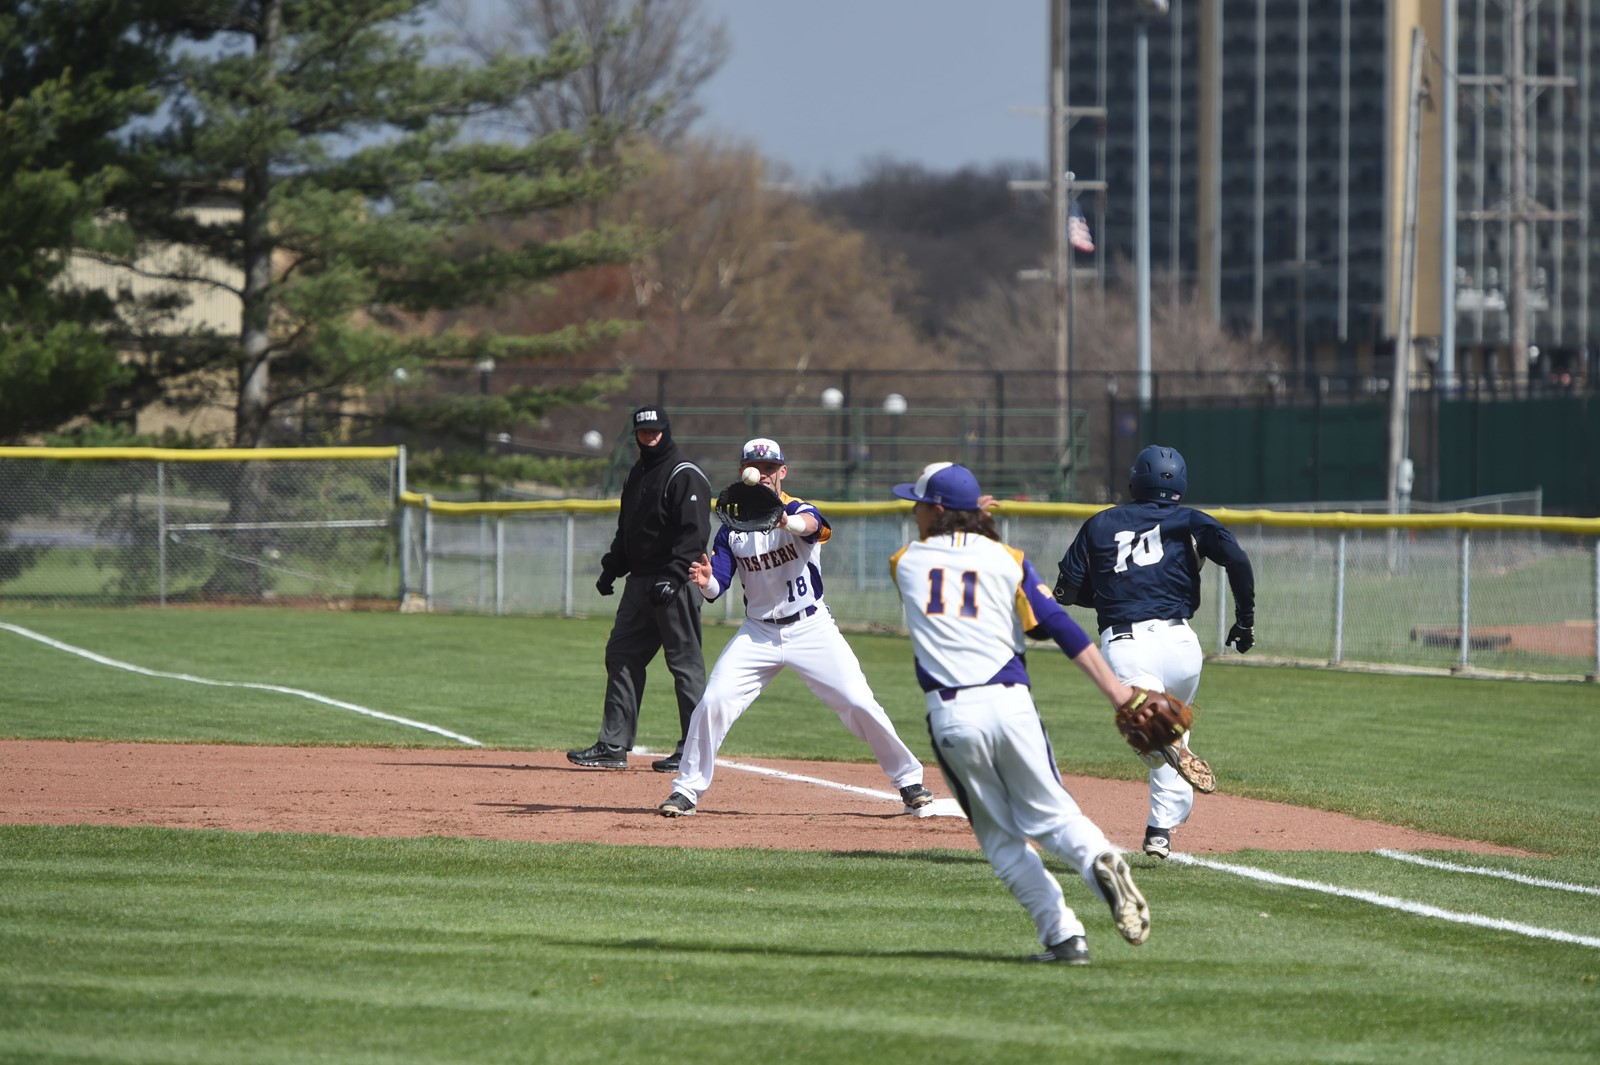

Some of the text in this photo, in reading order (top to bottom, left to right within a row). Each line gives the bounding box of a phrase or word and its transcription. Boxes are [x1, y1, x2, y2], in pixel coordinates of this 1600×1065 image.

[1113, 524, 1165, 574] 10
[786, 575, 808, 603] 18
[926, 568, 979, 619] 11
